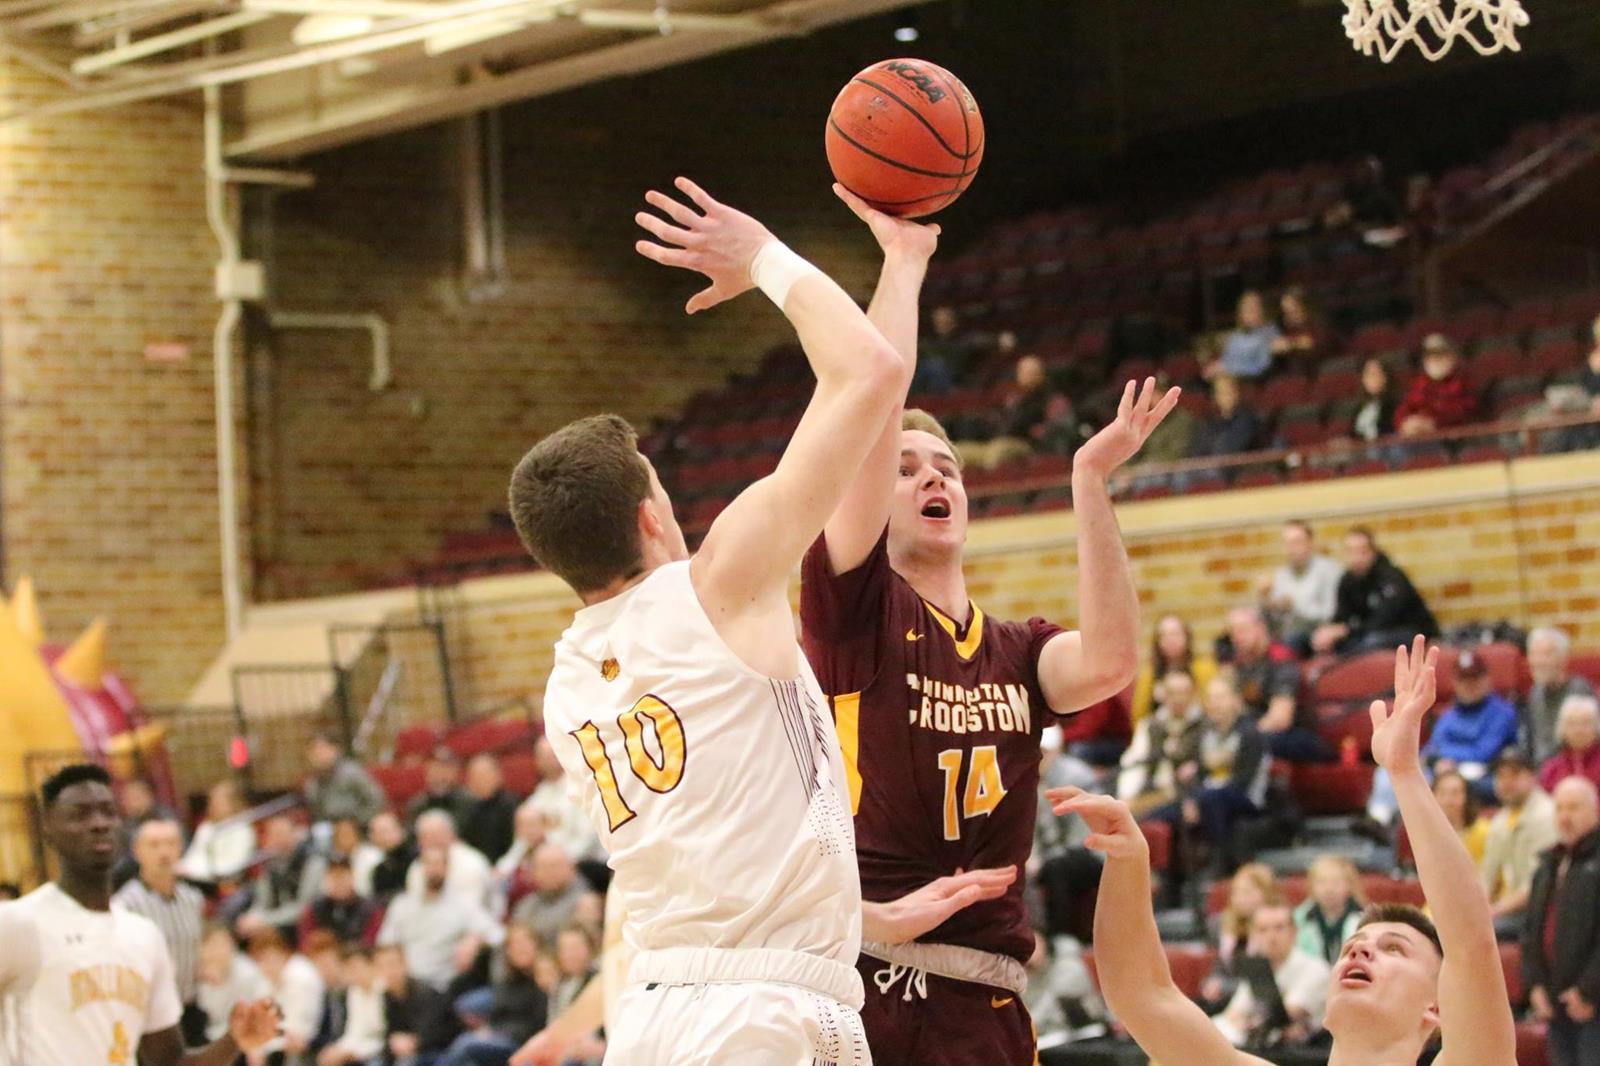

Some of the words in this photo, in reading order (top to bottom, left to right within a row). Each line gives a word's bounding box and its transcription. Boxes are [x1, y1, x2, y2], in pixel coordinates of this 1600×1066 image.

[906, 673, 1031, 735] ROOSTON
[568, 693, 687, 833] 10
[937, 745, 1008, 841] 14
